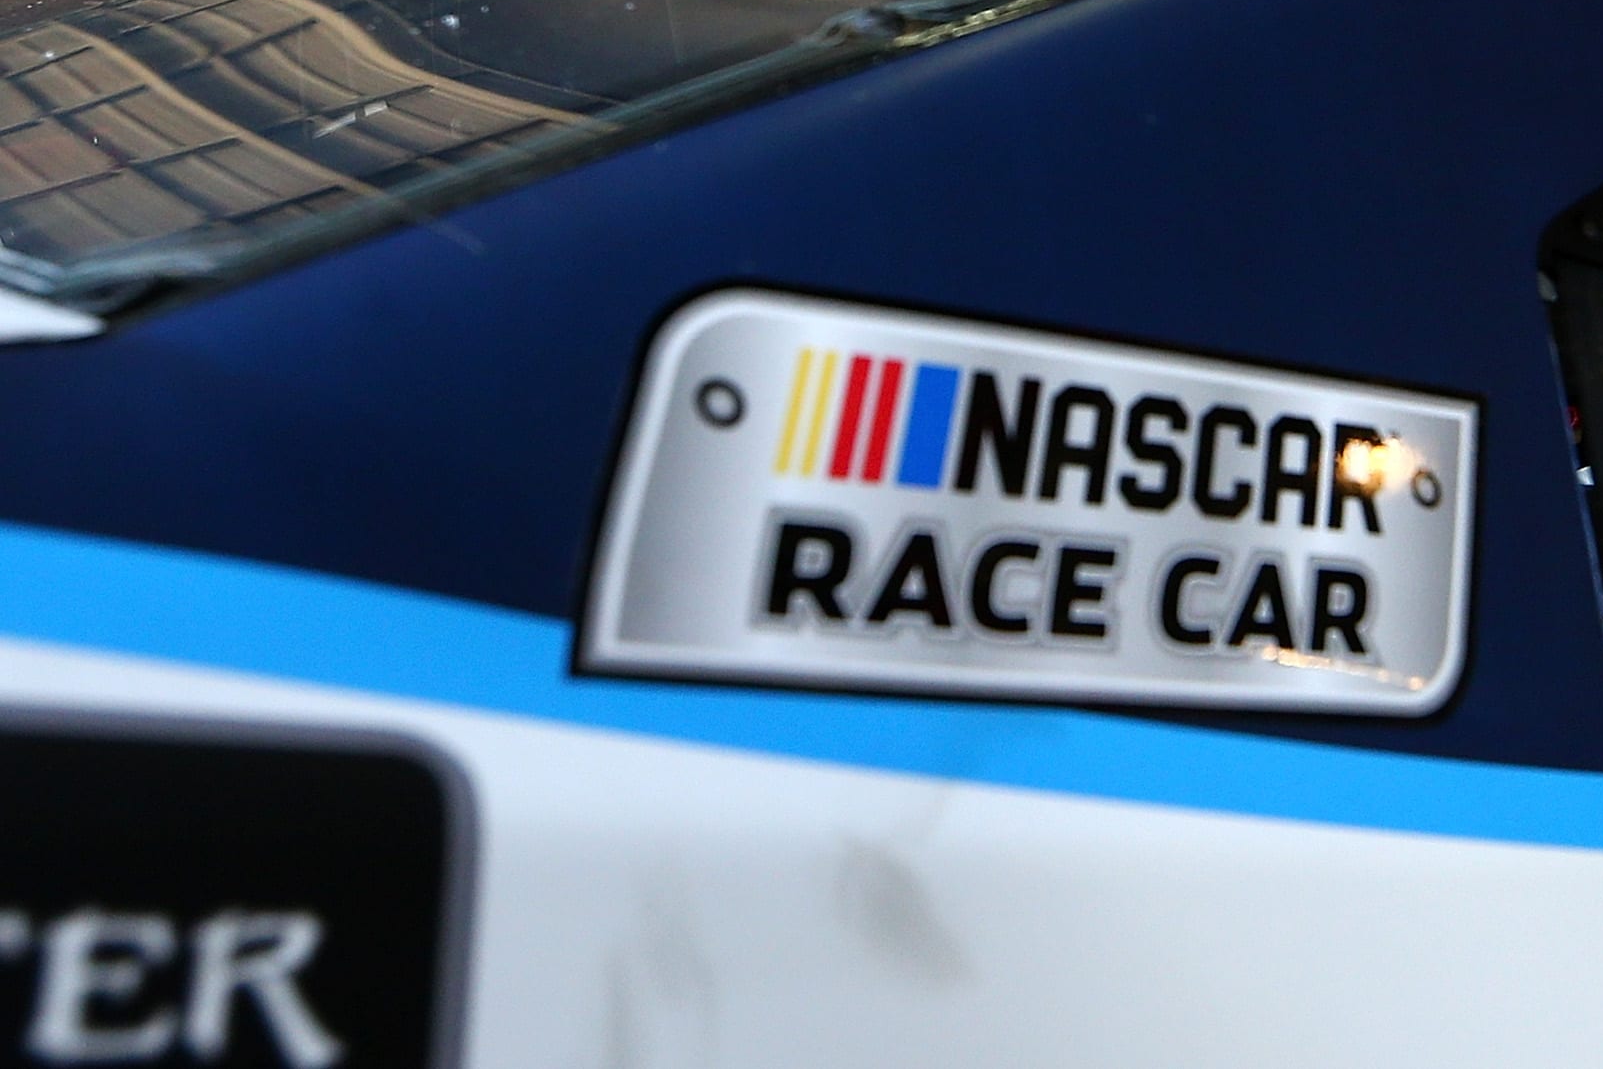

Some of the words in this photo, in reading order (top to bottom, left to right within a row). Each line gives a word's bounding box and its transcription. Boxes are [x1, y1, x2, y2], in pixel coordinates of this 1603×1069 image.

[952, 368, 1386, 535] NASCAR
[767, 523, 1117, 639] RACE
[1158, 556, 1372, 656] CAR
